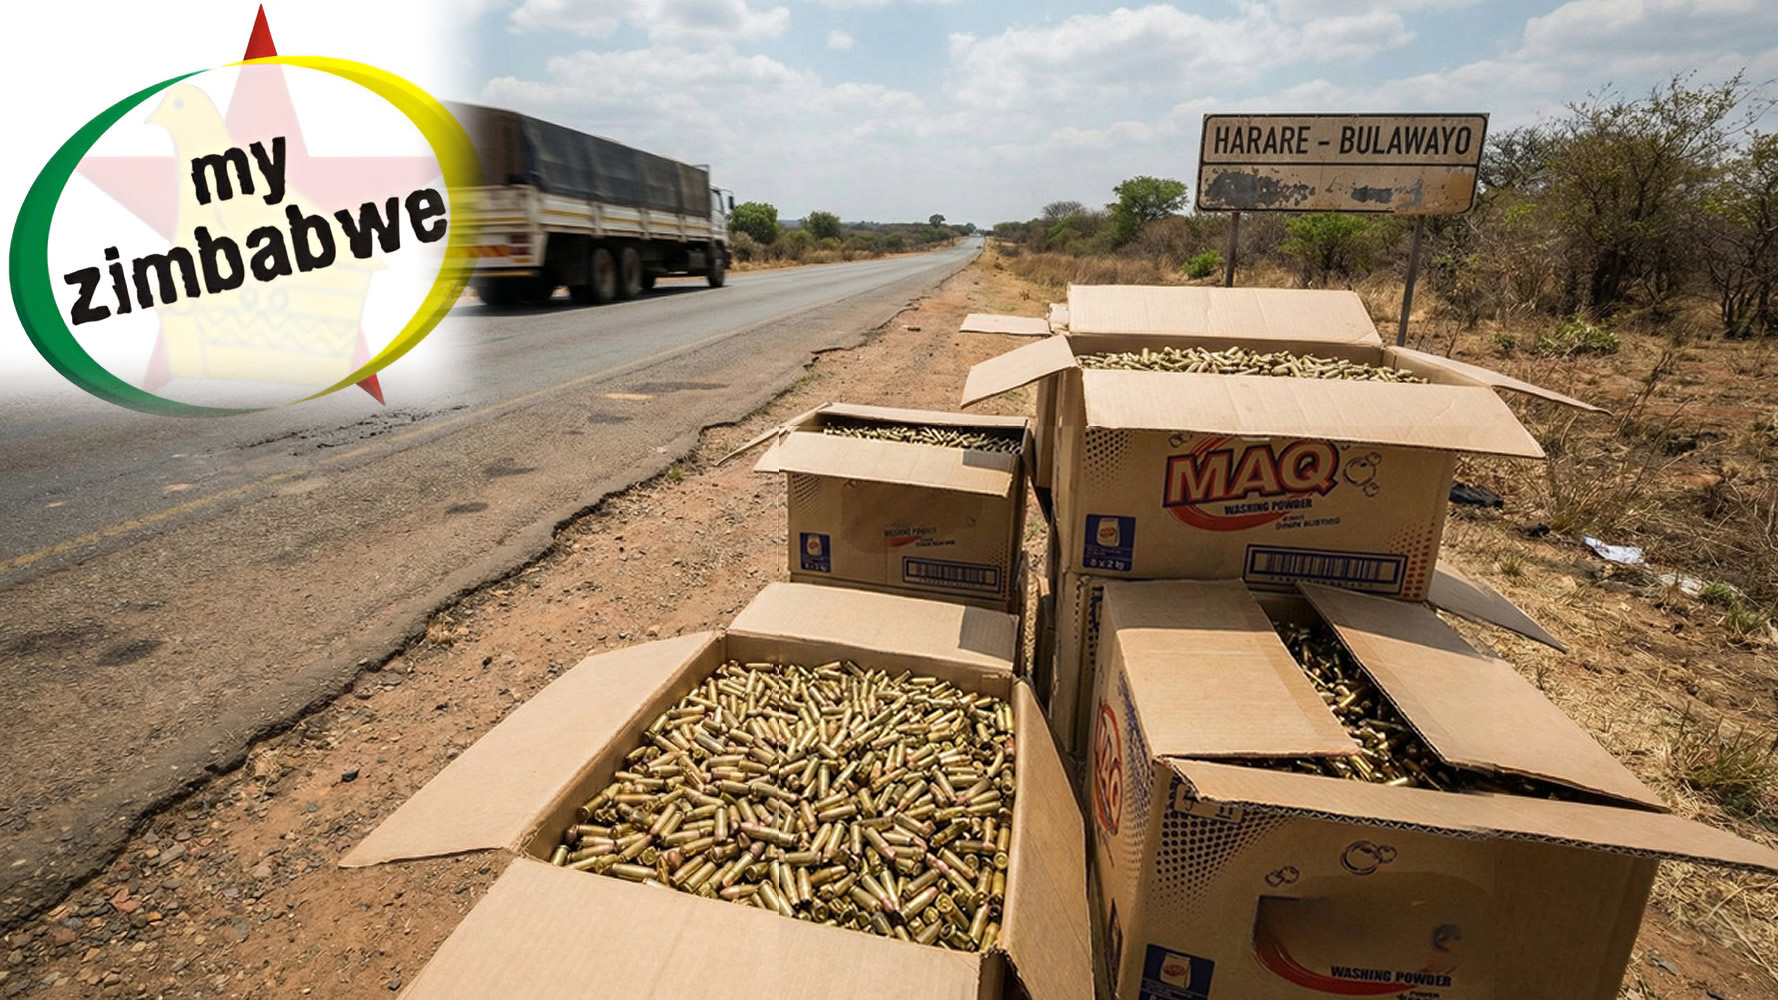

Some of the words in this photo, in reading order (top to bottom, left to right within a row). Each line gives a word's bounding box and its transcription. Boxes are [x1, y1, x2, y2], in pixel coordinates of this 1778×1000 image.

[1214, 126, 1311, 155] HARARE
[1339, 126, 1472, 155] BULAWAYO
[1162, 440, 1339, 508] MAQ
[1224, 502, 1270, 515] WASHING
[1272, 498, 1313, 512] POWDER
[1330, 966, 1392, 982] WASHING
[1395, 970, 1452, 987] POWDER
